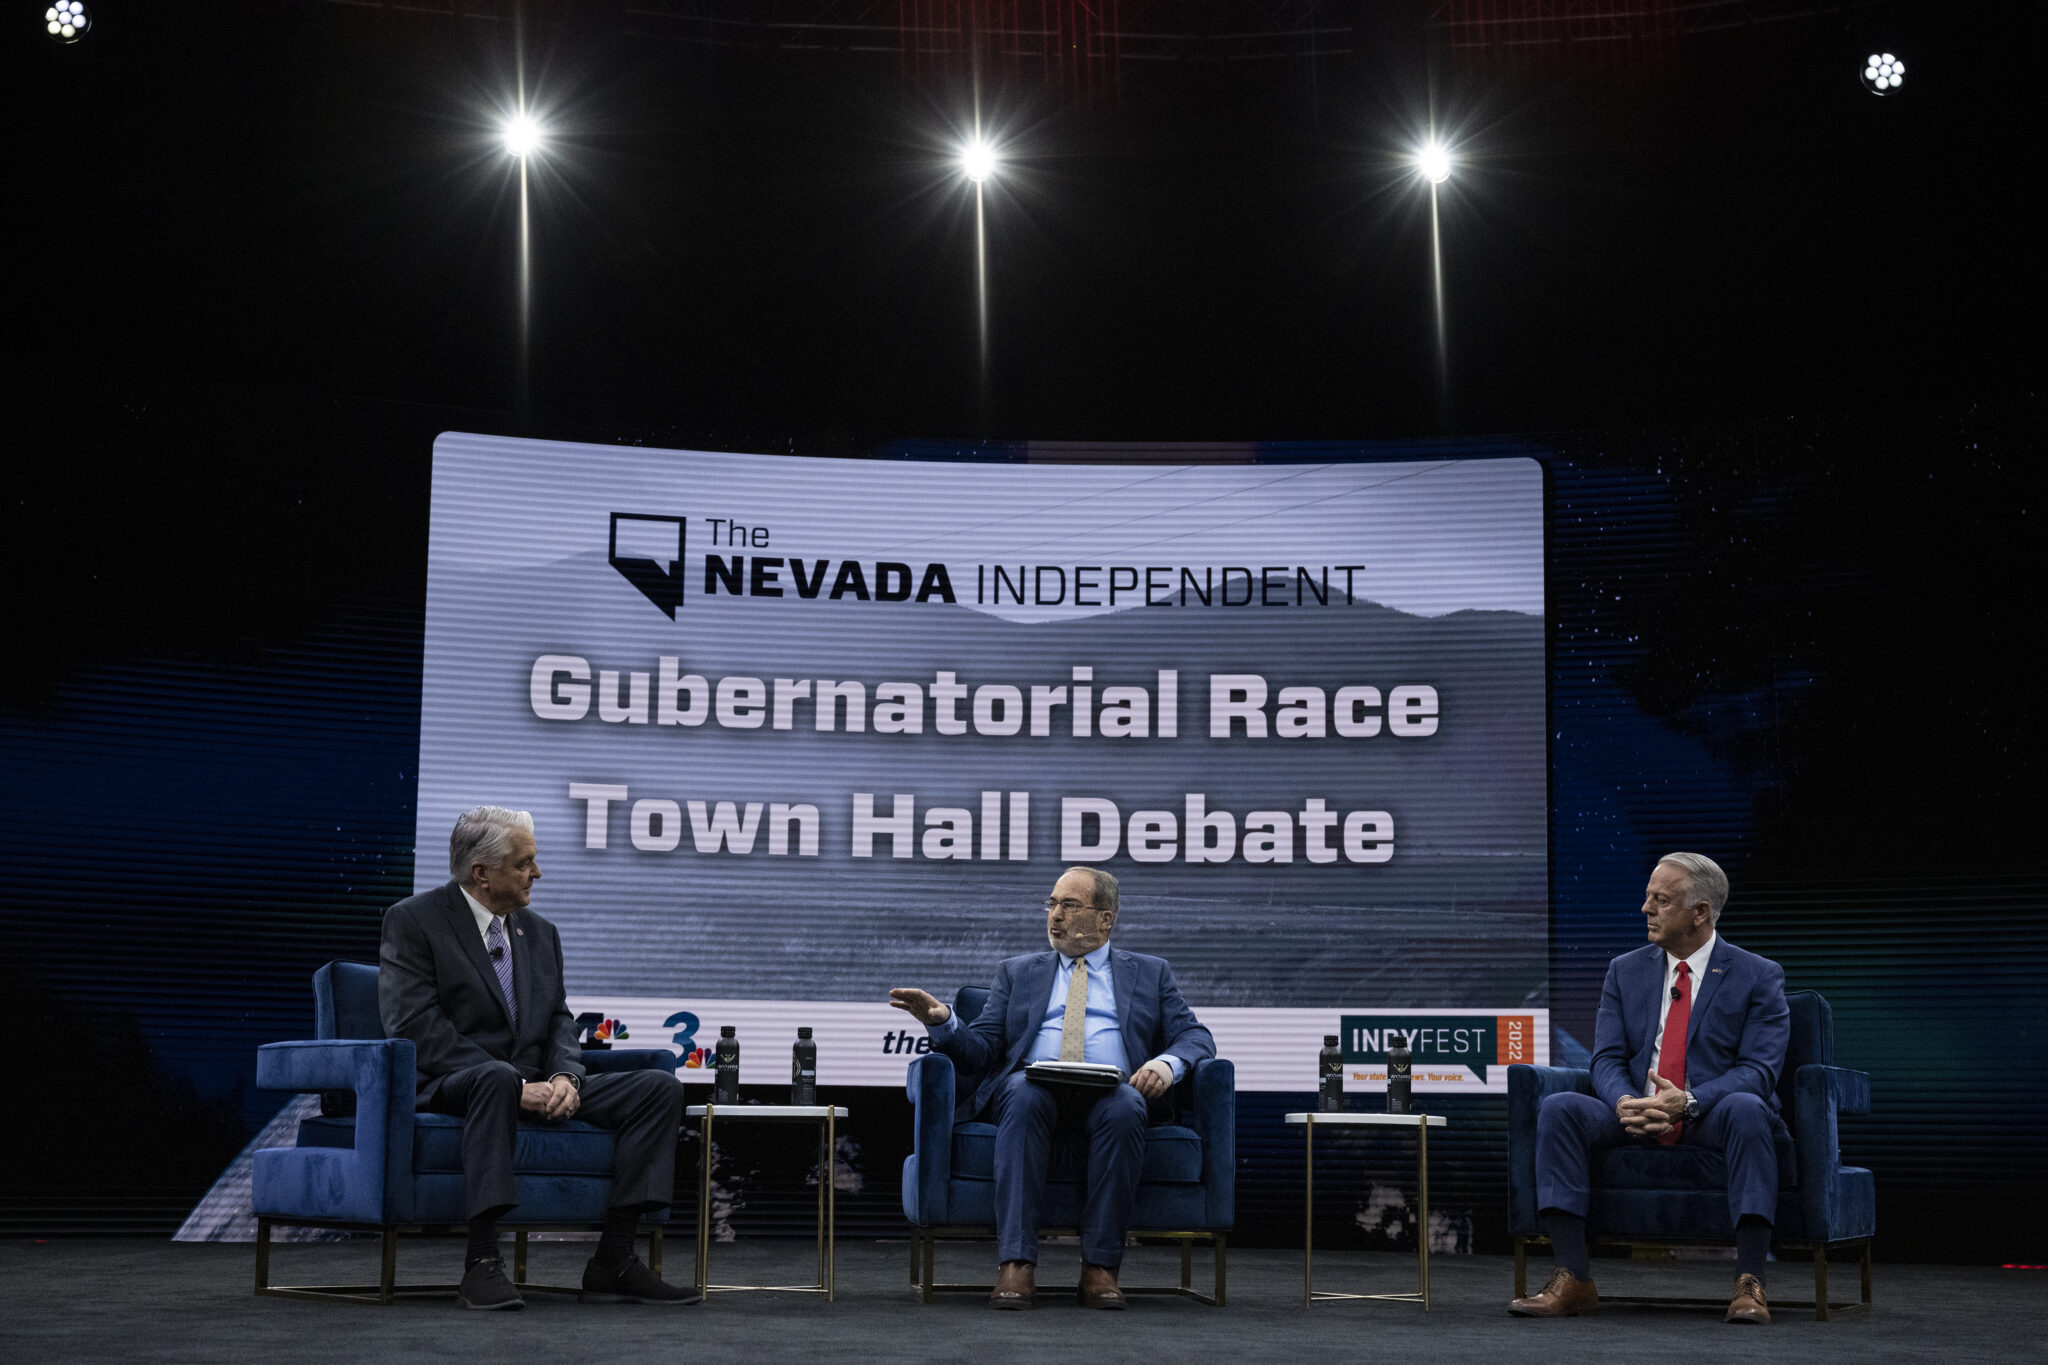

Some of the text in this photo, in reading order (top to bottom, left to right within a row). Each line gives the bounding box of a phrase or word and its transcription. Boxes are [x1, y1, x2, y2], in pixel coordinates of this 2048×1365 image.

[704, 518, 770, 548] The
[704, 554, 1366, 607] NEVADA INDEPENDENT
[529, 653, 1440, 739] Gubernatorial Race
[568, 782, 1396, 864] Town Hall Debate
[662, 1011, 700, 1068] 3
[883, 1030, 931, 1054] the
[1352, 1028, 1486, 1053] INDYFEST
[1508, 1021, 1522, 1060] 2022
[1353, 1072, 1368, 1080] Your
[1427, 1072, 1443, 1081] Your
[1444, 1073, 1464, 1081] voice.
